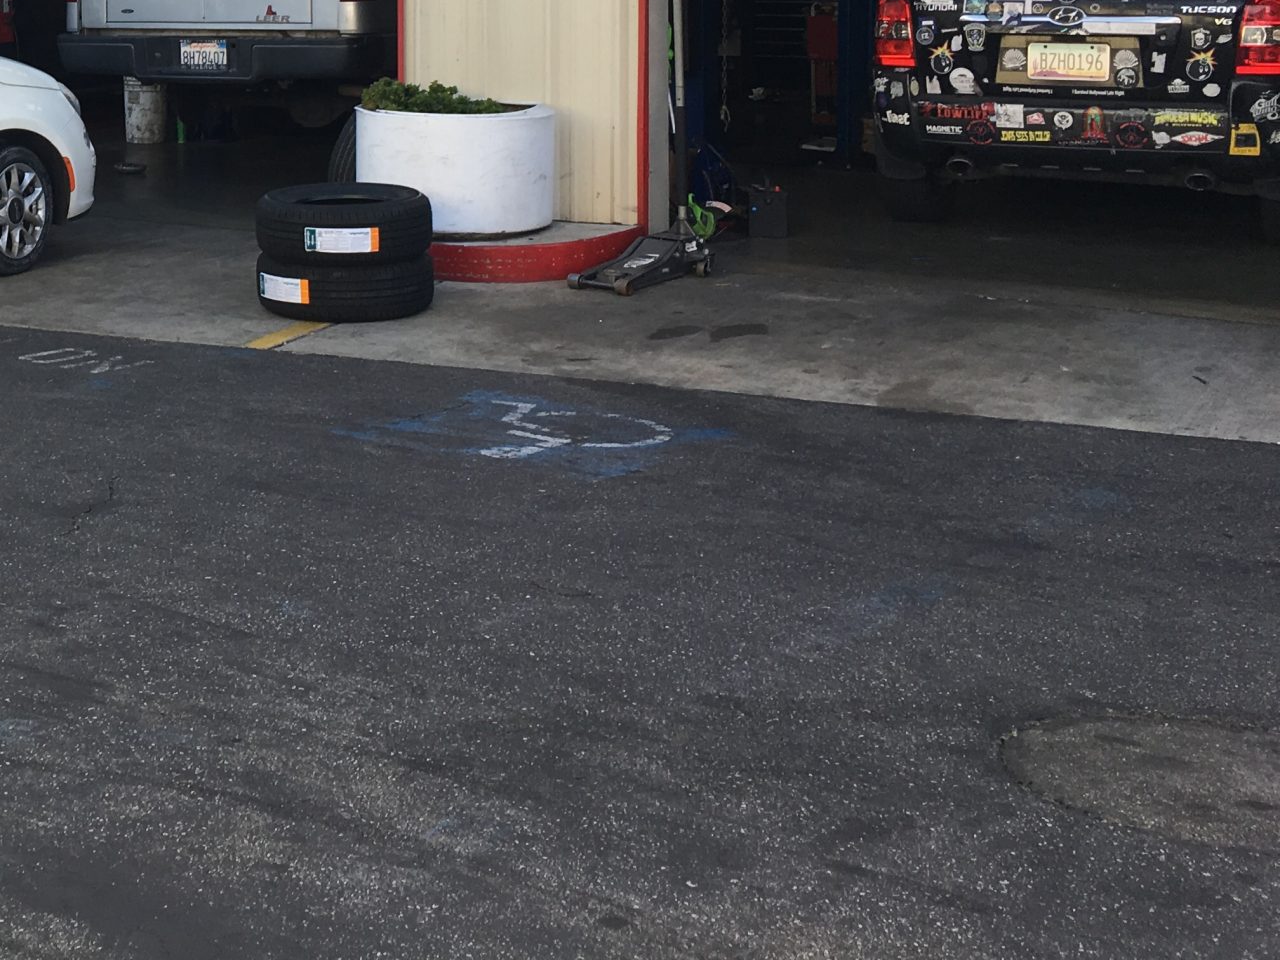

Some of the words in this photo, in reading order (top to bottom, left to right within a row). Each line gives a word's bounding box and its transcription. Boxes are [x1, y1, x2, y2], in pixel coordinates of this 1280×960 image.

[1181, 5, 1237, 14] TUCSON
[255, 14, 291, 24] LEER
[1214, 17, 1233, 26] V6
[1039, 52, 1104, 71] BZH0196
[925, 125, 963, 134] MAGNETIC
